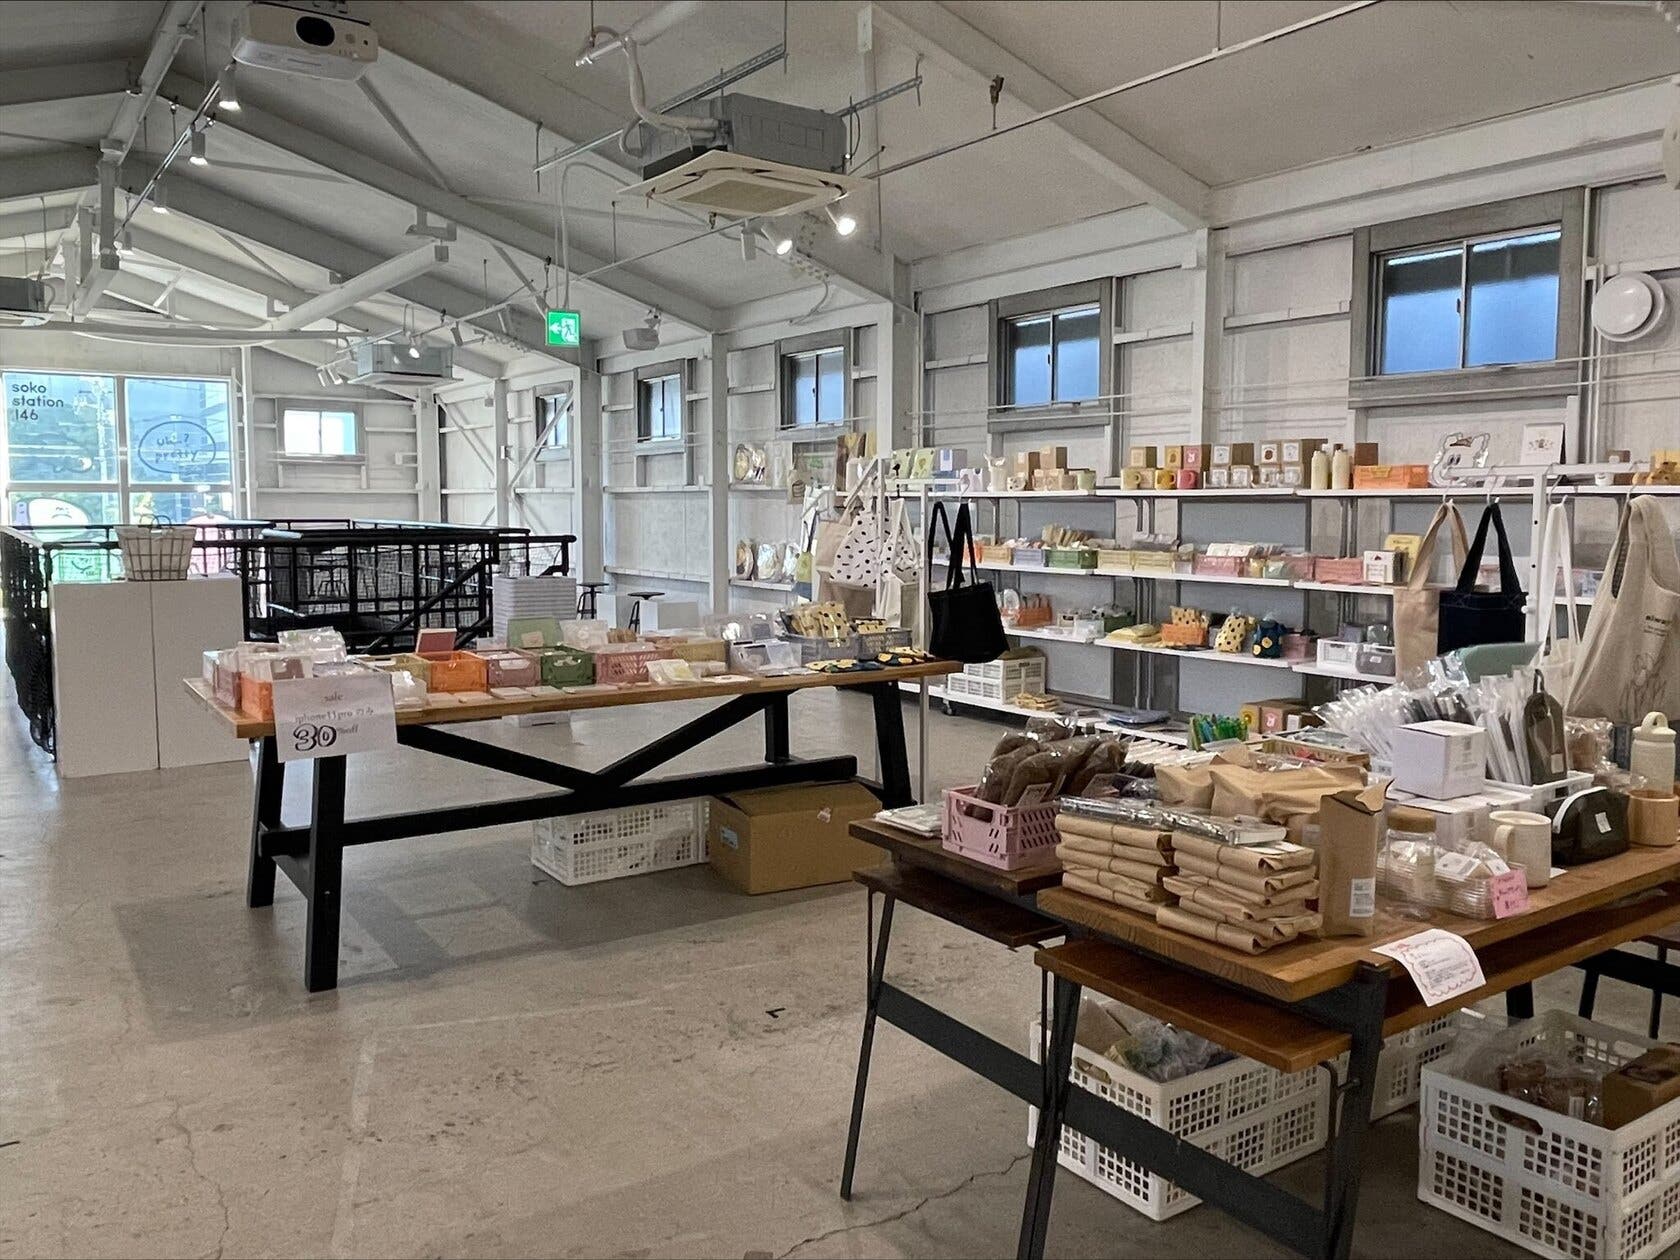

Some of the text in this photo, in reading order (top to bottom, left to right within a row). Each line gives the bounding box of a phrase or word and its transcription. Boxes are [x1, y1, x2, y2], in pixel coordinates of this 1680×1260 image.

[12, 381, 47, 393] soko
[12, 395, 64, 407] station
[15, 409, 39, 420] 146
[293, 723, 337, 752] 30
